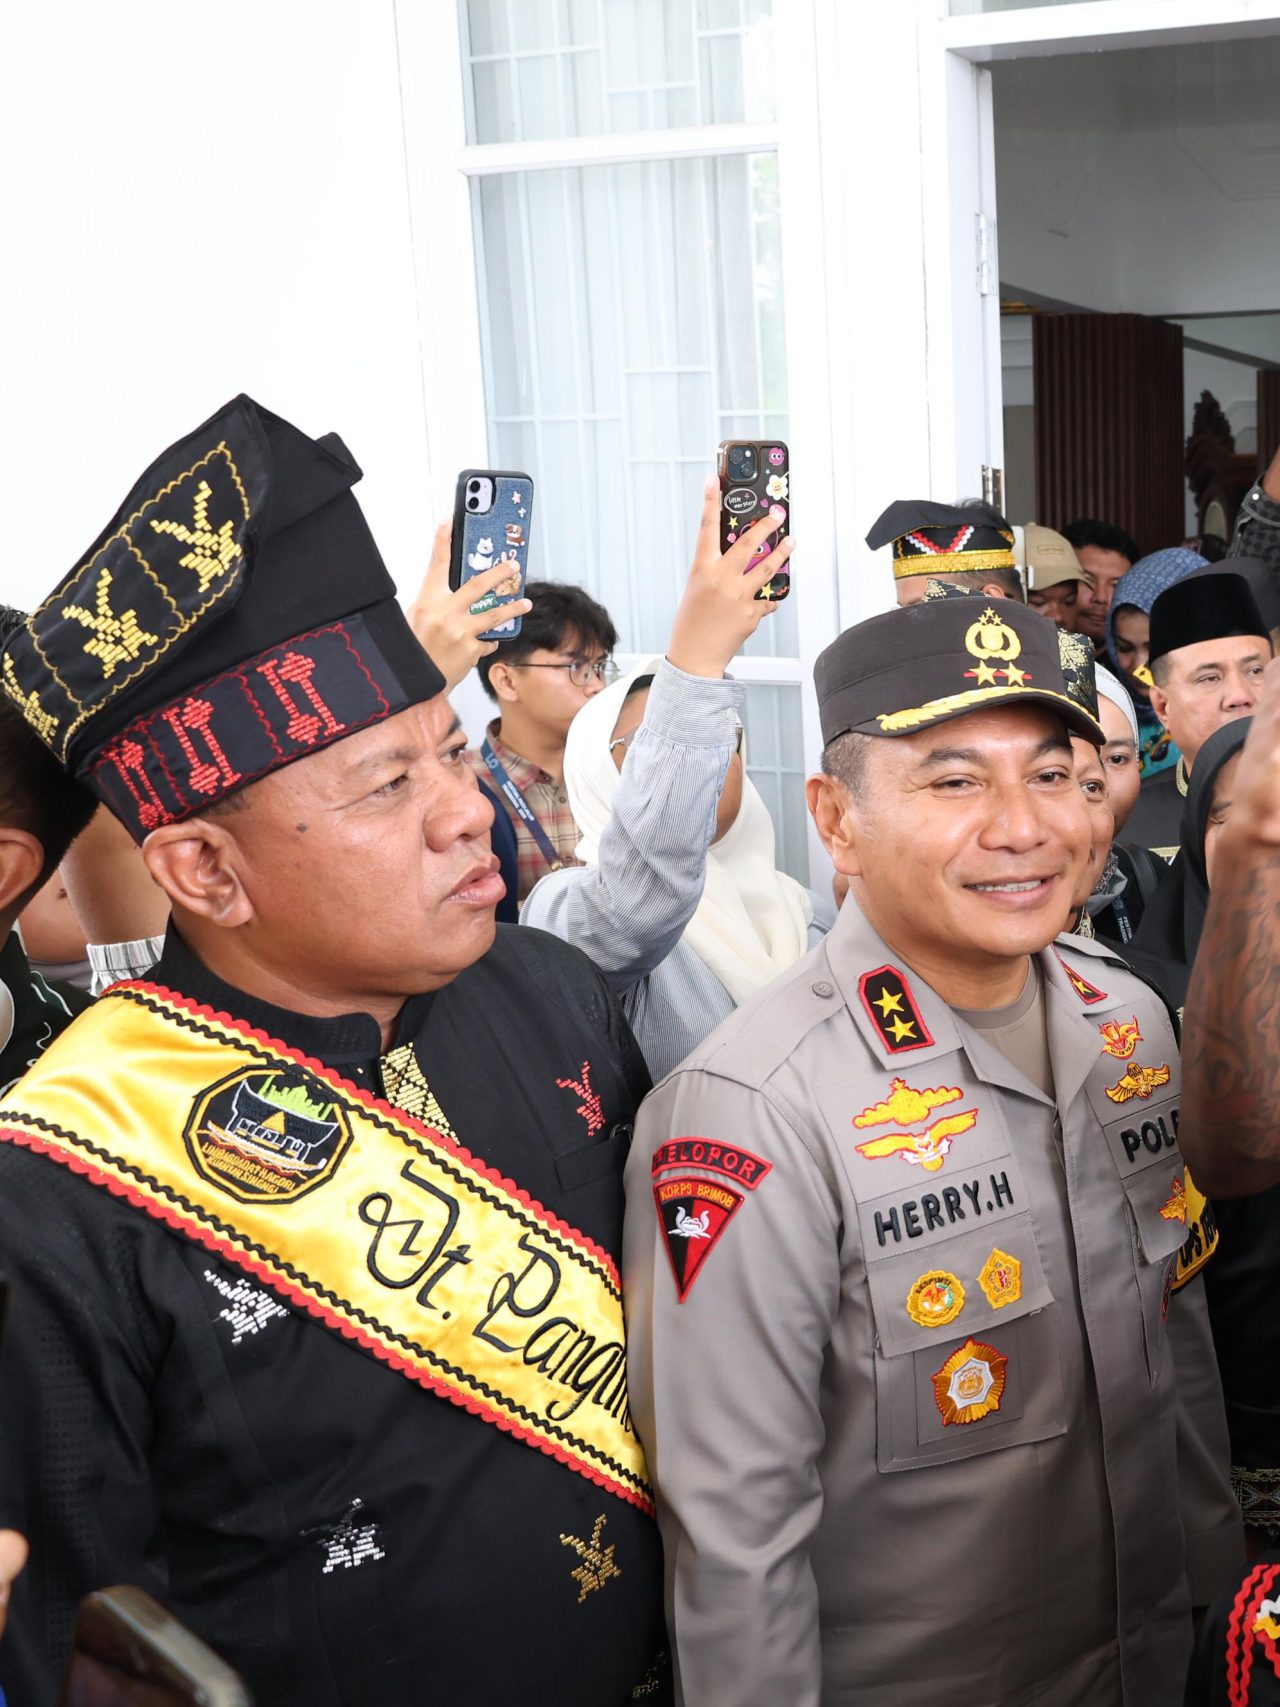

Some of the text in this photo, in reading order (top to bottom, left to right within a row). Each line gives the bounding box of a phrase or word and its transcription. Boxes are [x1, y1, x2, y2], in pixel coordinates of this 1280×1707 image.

[660, 1183, 735, 1208] KORPS BRIMOB
[873, 1171, 1014, 1247] HERRY.H
